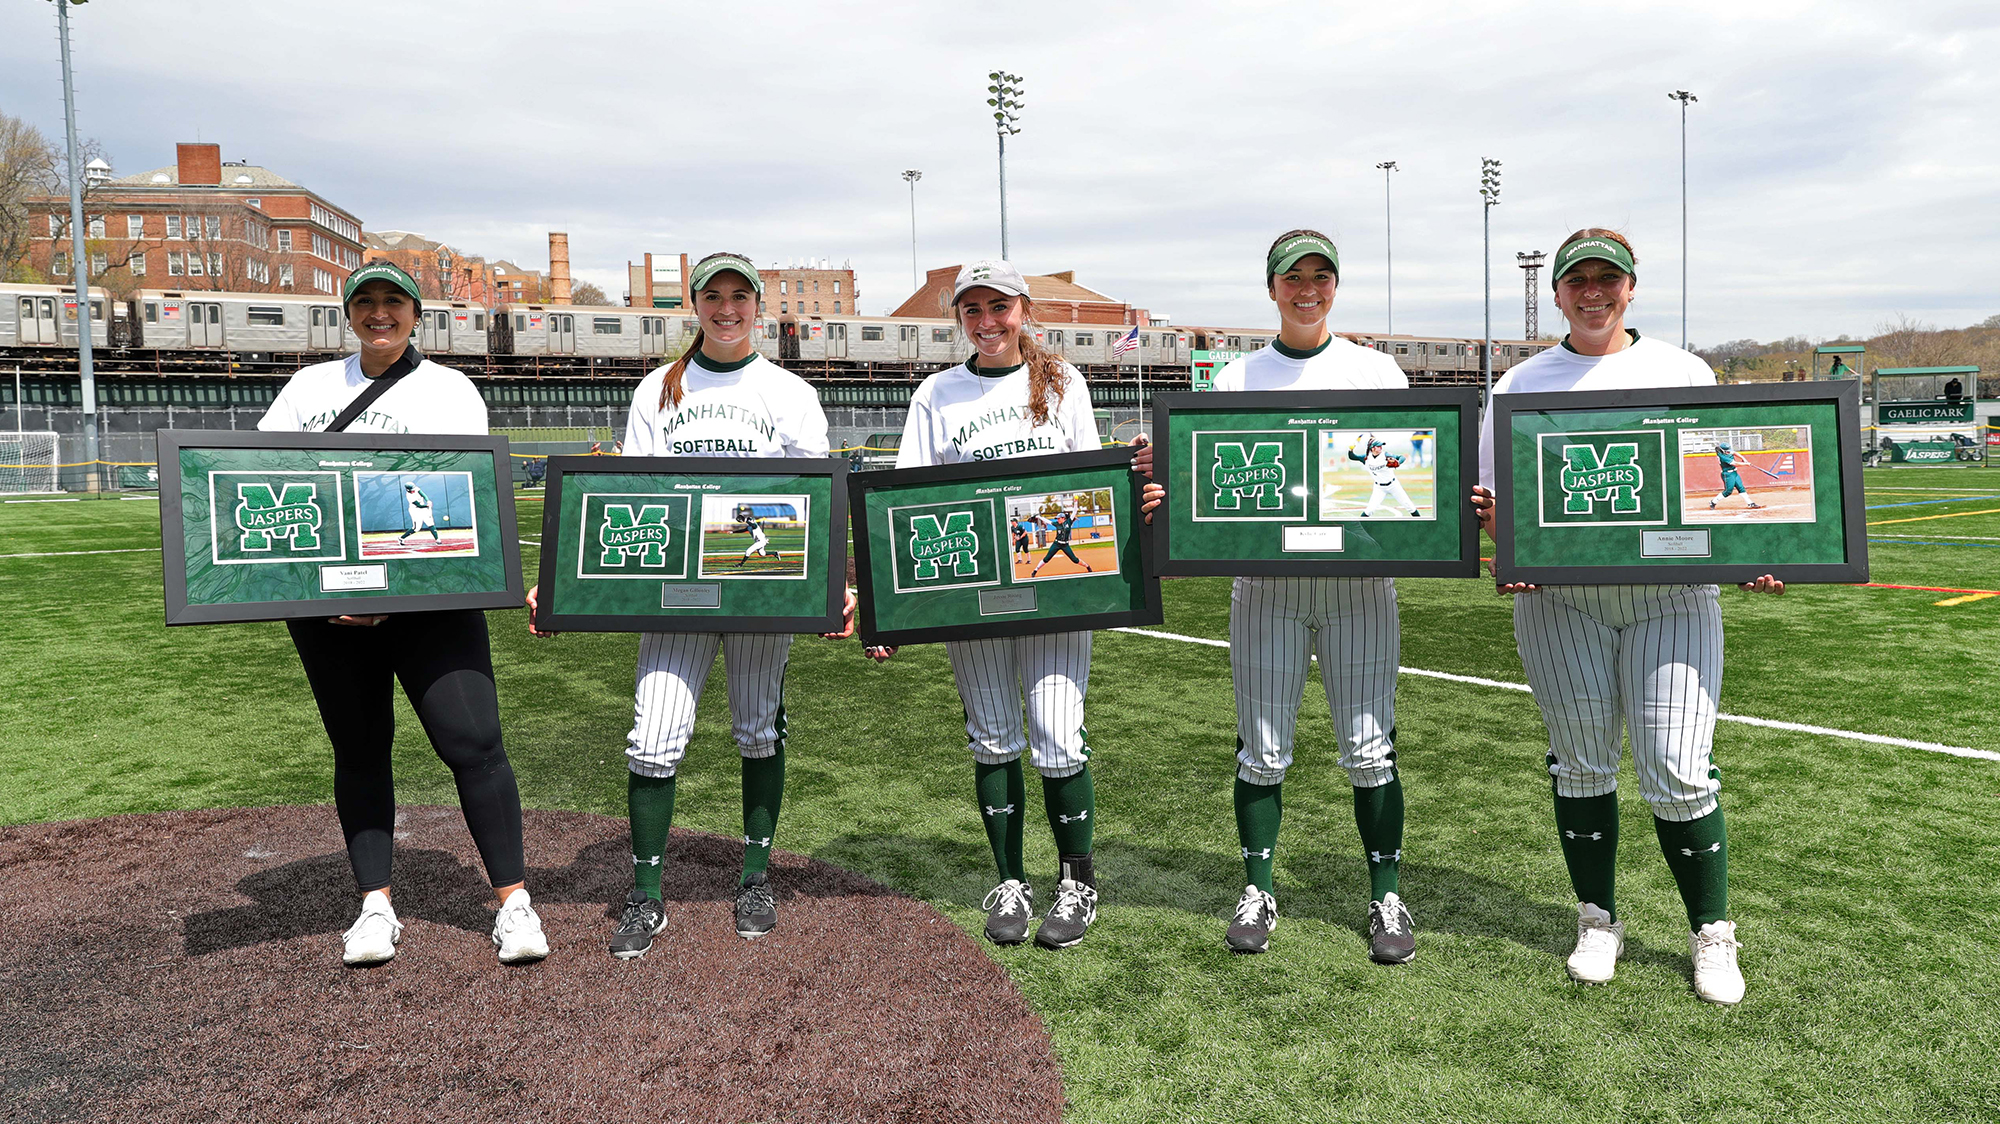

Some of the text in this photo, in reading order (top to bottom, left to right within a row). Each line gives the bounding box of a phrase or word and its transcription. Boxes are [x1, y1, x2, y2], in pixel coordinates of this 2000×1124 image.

[1286, 238, 1330, 254] MANHATTAN
[1566, 240, 1616, 260] MANHATTAN
[704, 259, 749, 272] MANHATTAN
[354, 267, 402, 283] MANHATTAN
[1208, 350, 1239, 360] GAELIC
[1888, 408, 1964, 418] GAELIC PARK
[663, 403, 775, 445] MANHATTAN
[673, 439, 757, 454] SOFTBALL
[972, 437, 1055, 461] SOFTBALL
[1904, 447, 1952, 460] JASPERS
[1221, 468, 1278, 485] JASPERS
[1570, 469, 1634, 488] JASPERS
[975, 487, 1002, 495] Manhattan
[246, 508, 313, 526] JASPERS
[608, 528, 663, 543] JASPERS
[920, 536, 971, 556] JASPERS
